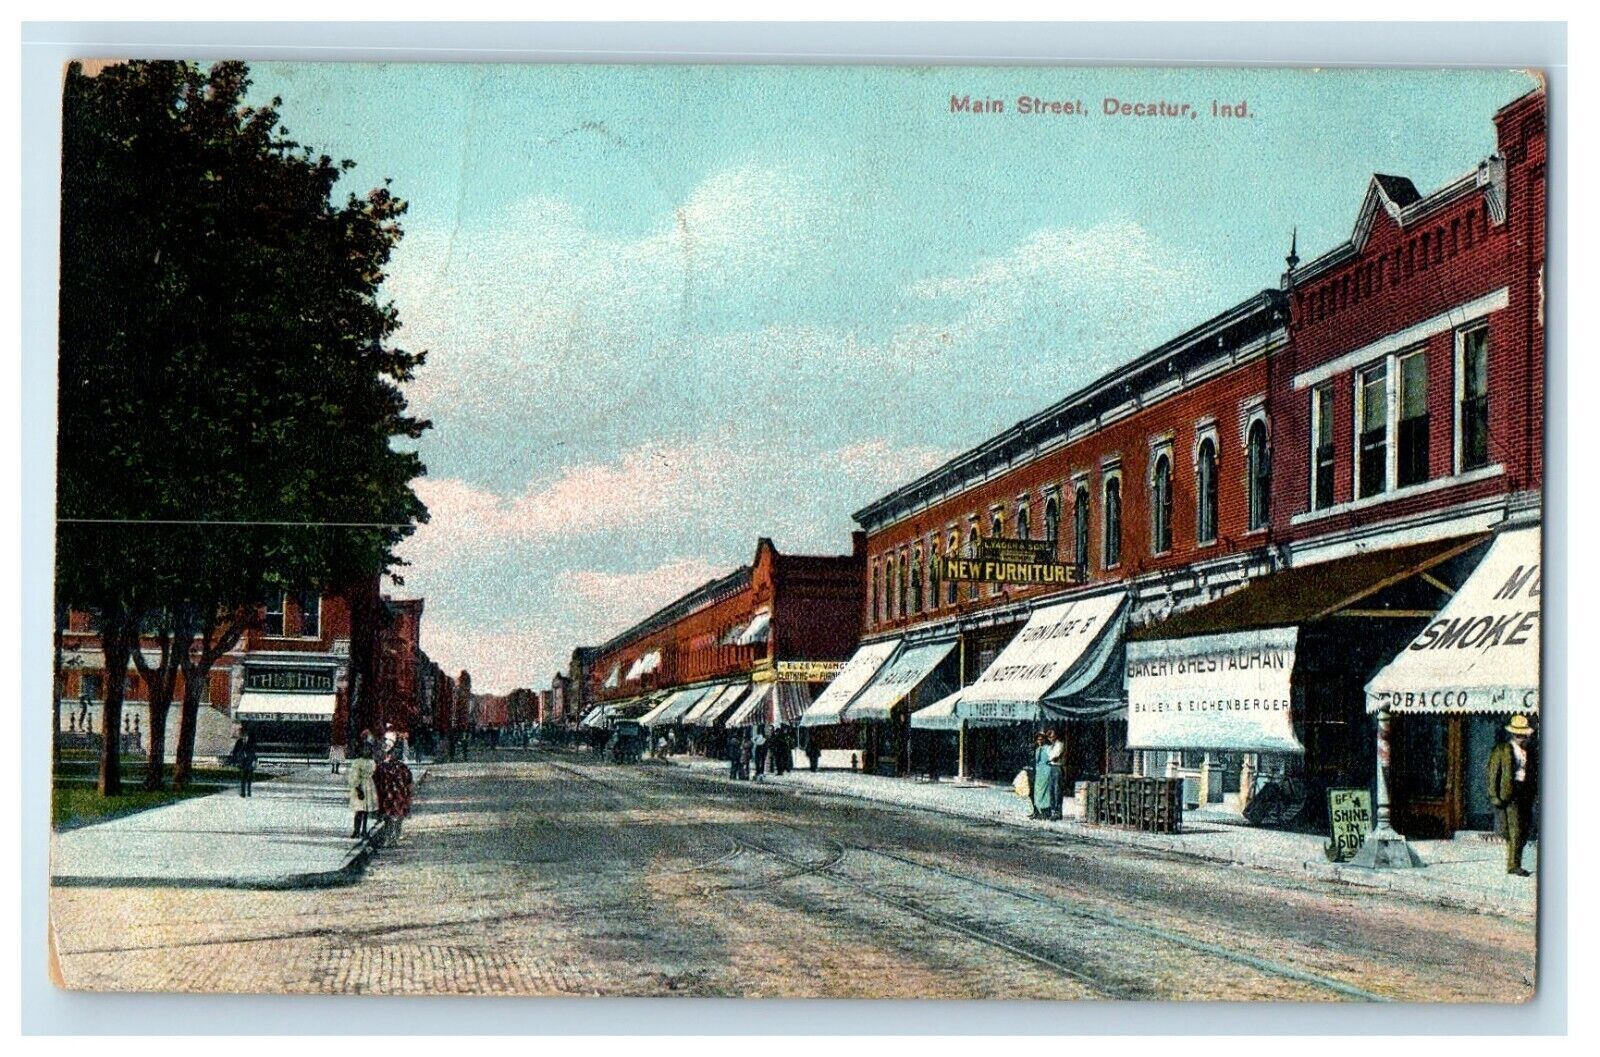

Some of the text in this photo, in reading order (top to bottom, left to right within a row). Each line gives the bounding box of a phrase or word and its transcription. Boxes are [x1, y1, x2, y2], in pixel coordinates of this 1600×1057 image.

[947, 560, 1077, 583] NEW FURNITURE
[1409, 611, 1539, 651] SMOKE
[1333, 808, 1369, 823] SHINE
